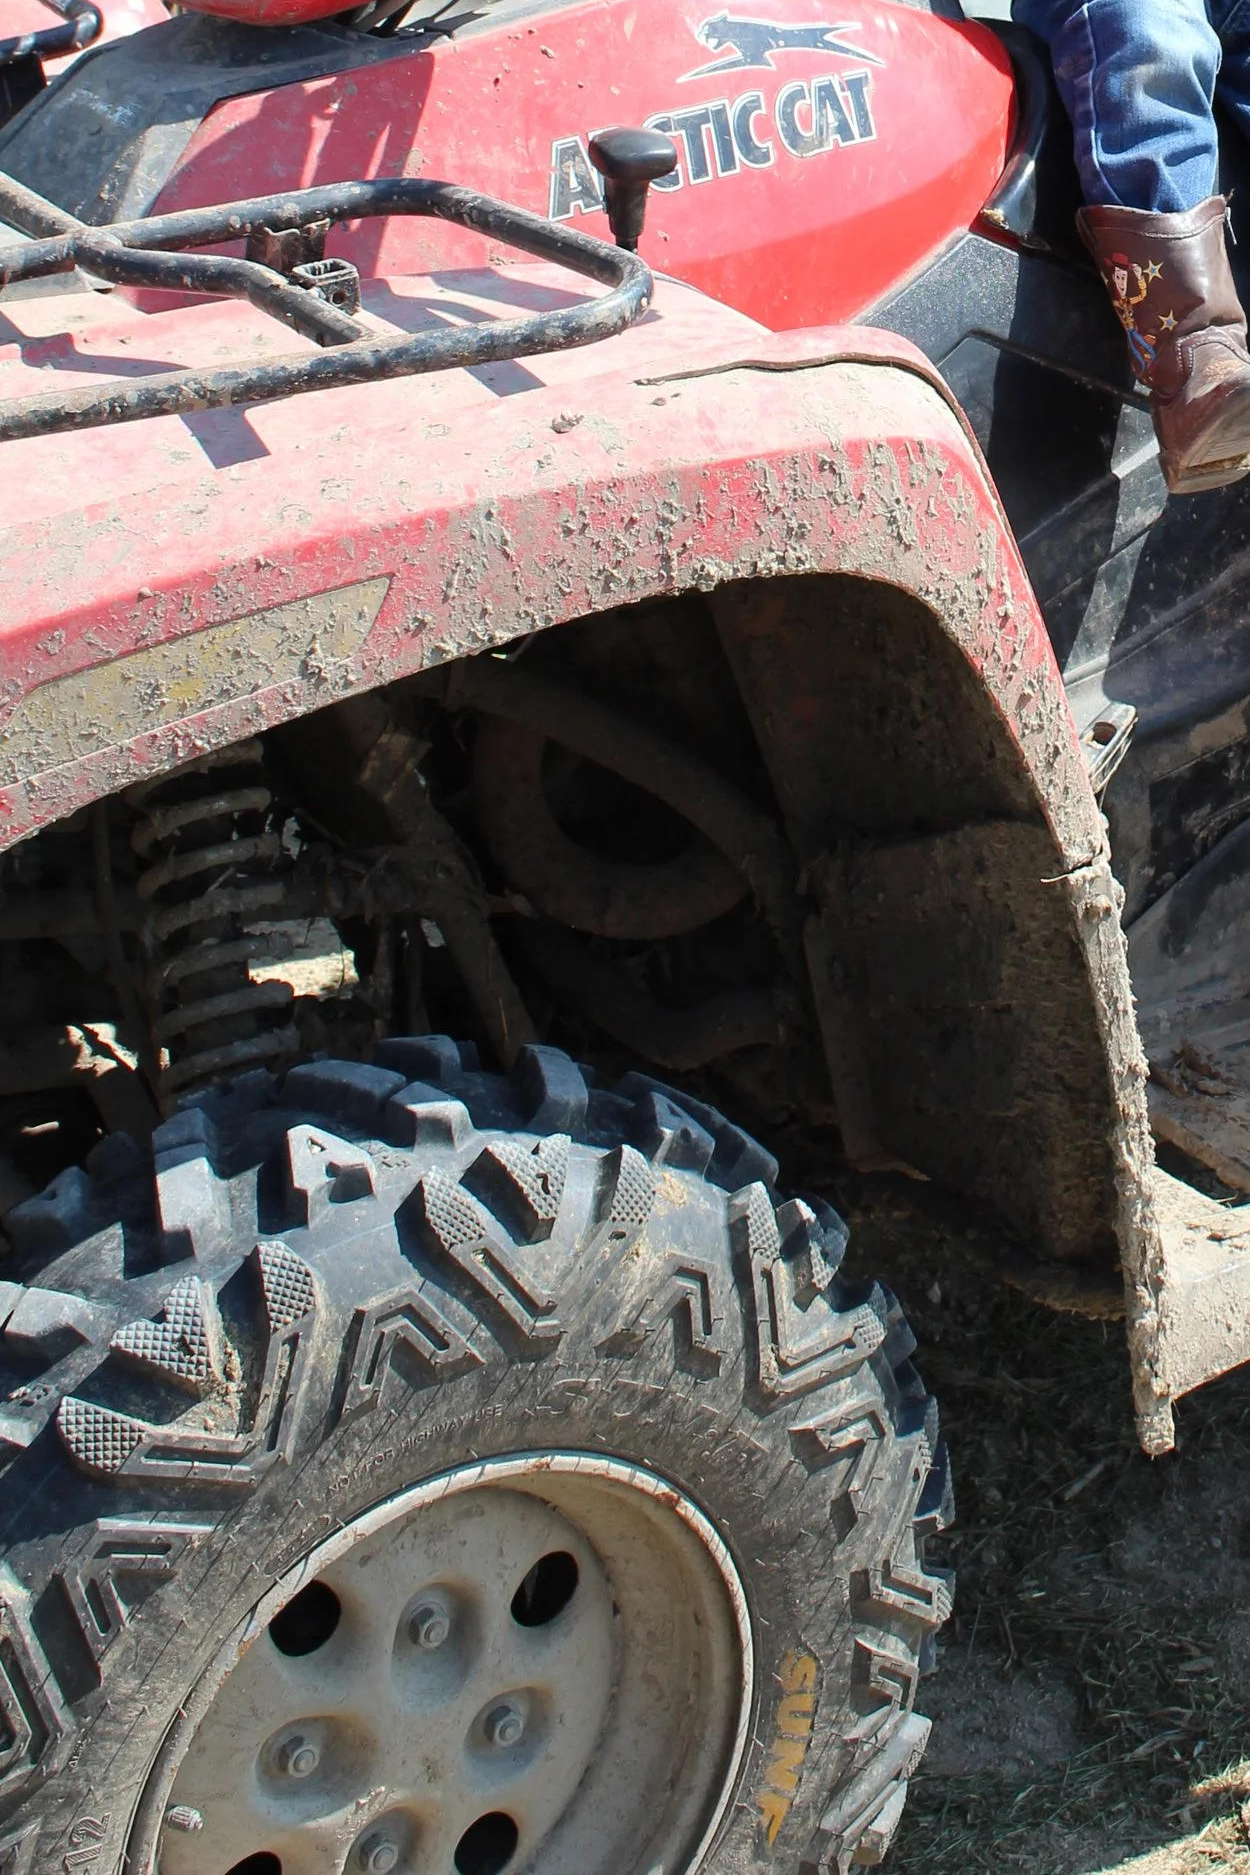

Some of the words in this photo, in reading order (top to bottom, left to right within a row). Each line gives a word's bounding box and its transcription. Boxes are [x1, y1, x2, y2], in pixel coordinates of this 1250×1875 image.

[547, 90, 776, 222] ACTIC
[775, 69, 878, 158] CAT
[364, 1448, 395, 1473] FOR
[400, 1413, 468, 1452] HIGHWAY
